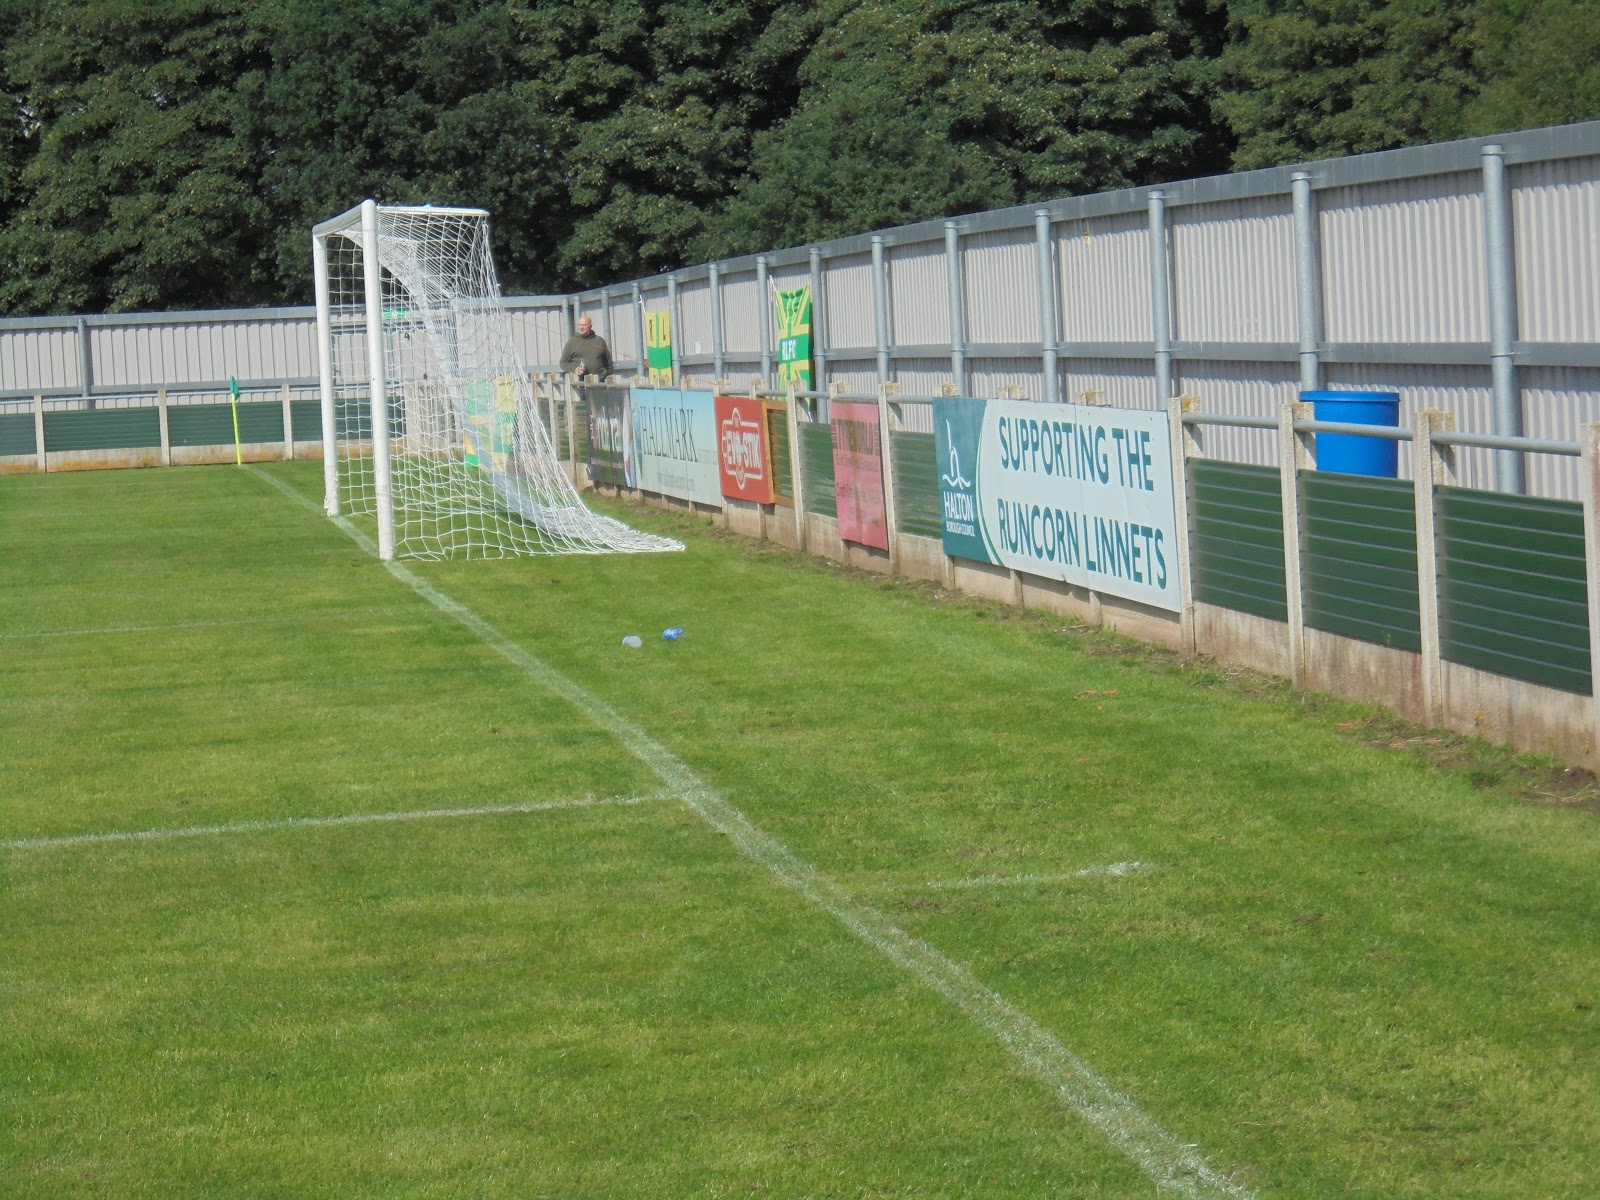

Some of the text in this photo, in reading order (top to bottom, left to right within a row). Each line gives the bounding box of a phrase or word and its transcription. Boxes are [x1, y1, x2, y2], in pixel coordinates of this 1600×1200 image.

[639, 406, 699, 463] HALLMARK
[998, 415, 1154, 492] SUPPORTING THE
[943, 490, 974, 522] HALTON
[997, 498, 1167, 590] RUNCORN LINNETS
